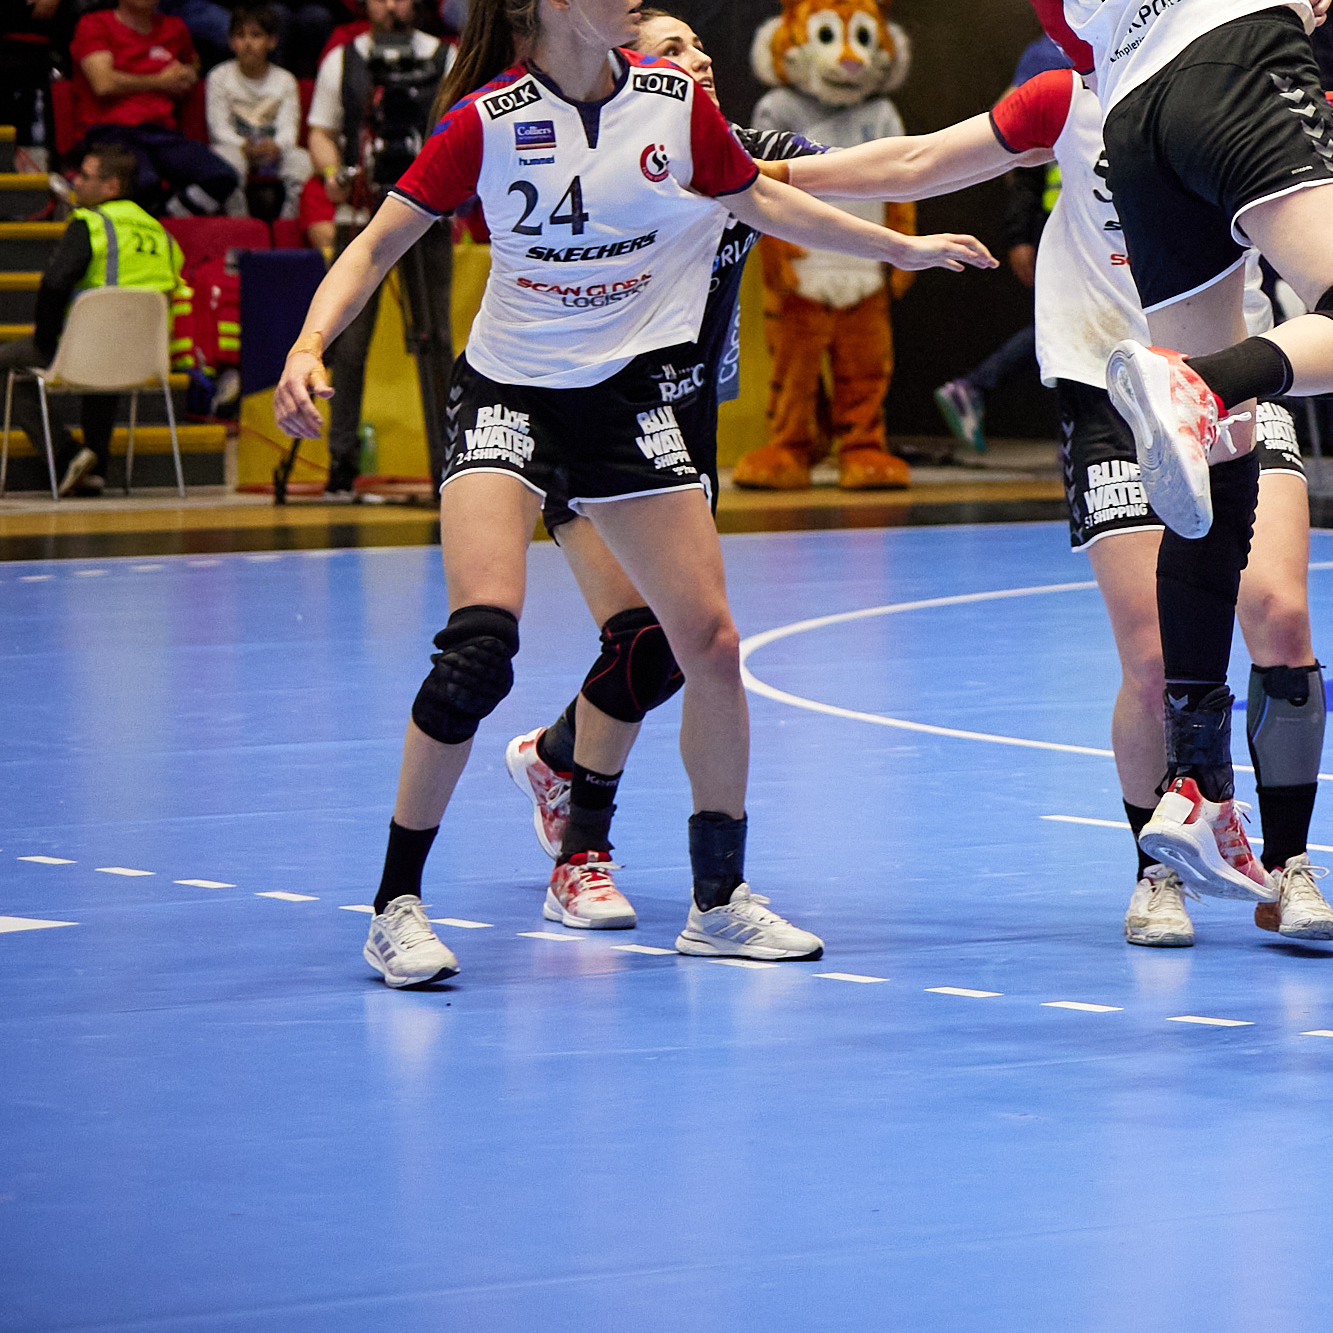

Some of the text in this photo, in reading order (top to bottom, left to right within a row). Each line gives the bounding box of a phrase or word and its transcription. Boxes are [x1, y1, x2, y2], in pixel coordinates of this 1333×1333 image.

[635, 75, 686, 99] LOLK
[486, 86, 538, 116] LOLK
[516, 125, 552, 137] Colliers
[507, 175, 589, 235] 24
[525, 229, 659, 262] SKECHERS
[516, 277, 581, 297] SCAN
[464, 424, 535, 462] WATER
[1093, 502, 1149, 524] SHIPPING
